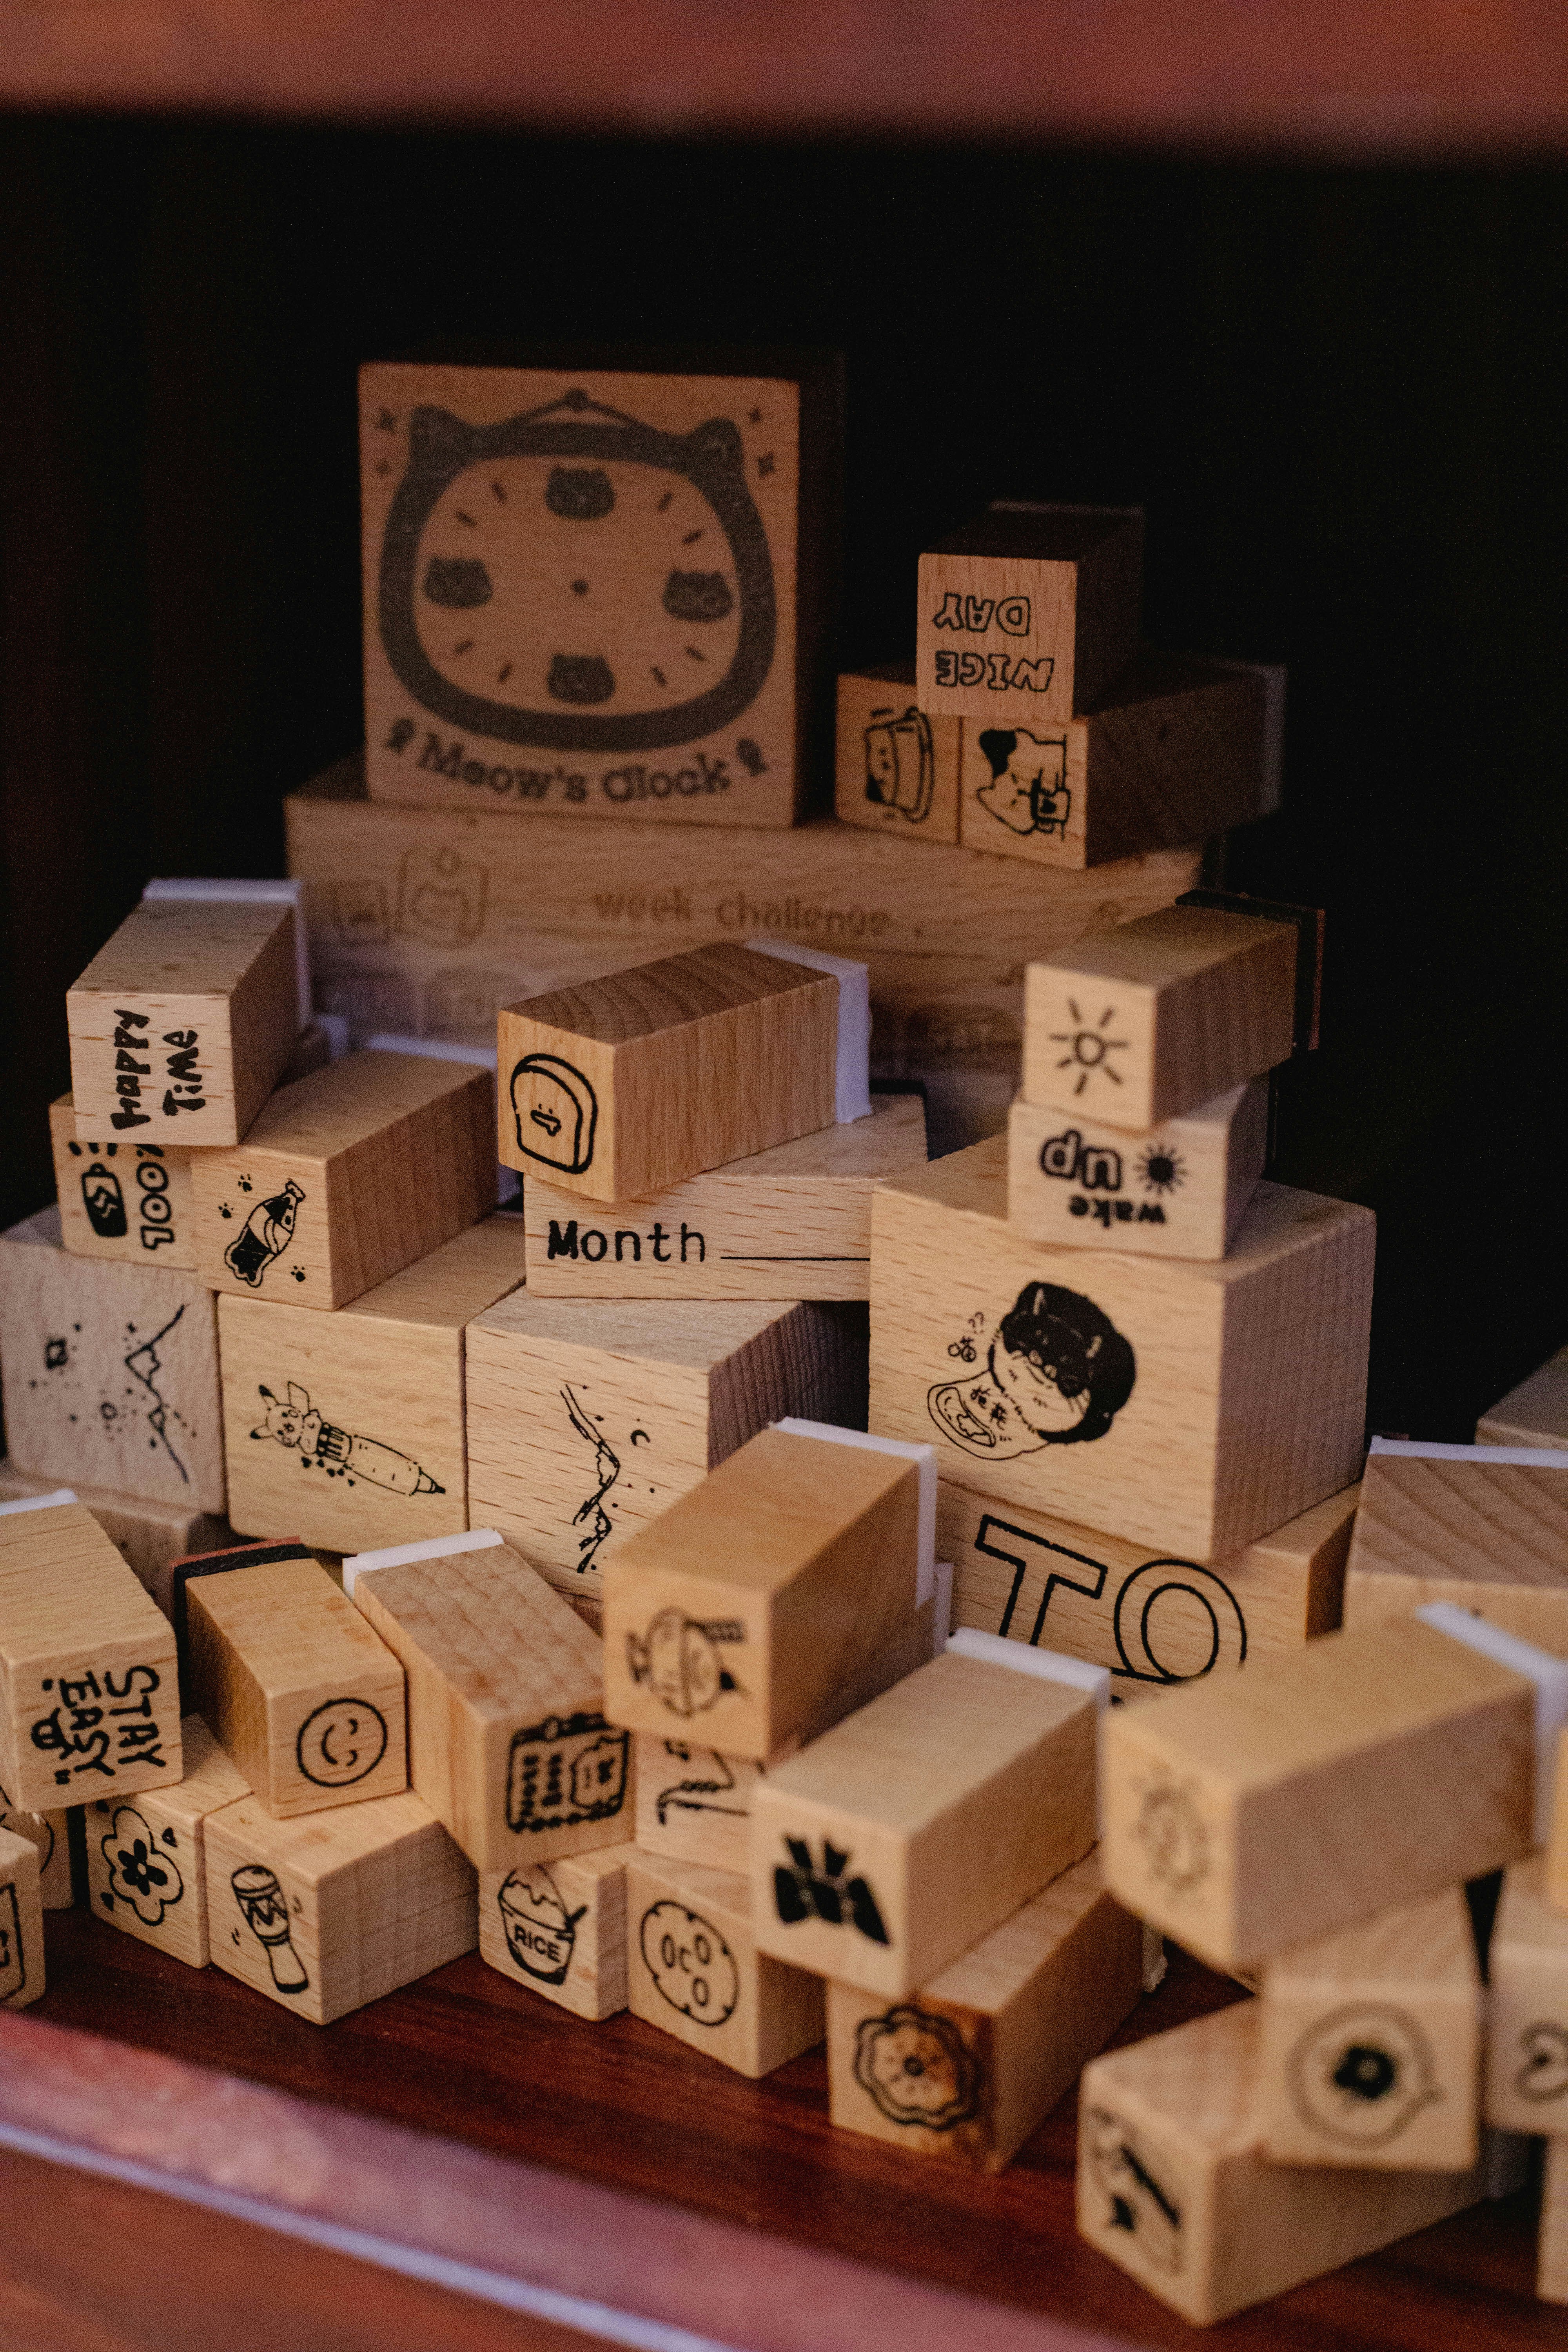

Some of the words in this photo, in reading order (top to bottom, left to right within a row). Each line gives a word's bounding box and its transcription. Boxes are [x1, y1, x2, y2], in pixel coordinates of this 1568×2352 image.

[933, 592, 1031, 637] DAY
[935, 650, 1054, 693] NICE
[417, 732, 588, 803] Meow's
[601, 751, 731, 803] Clock
[592, 885, 693, 923] week
[714, 890, 891, 938] challenge
[1040, 1129, 1123, 1192] up
[1068, 1194, 1167, 1229] wake
[548, 1220, 706, 1263] Month
[974, 1514, 1247, 1685] TO
[59, 1670, 115, 1777] EASY
[104, 1666, 167, 1767] STAY
